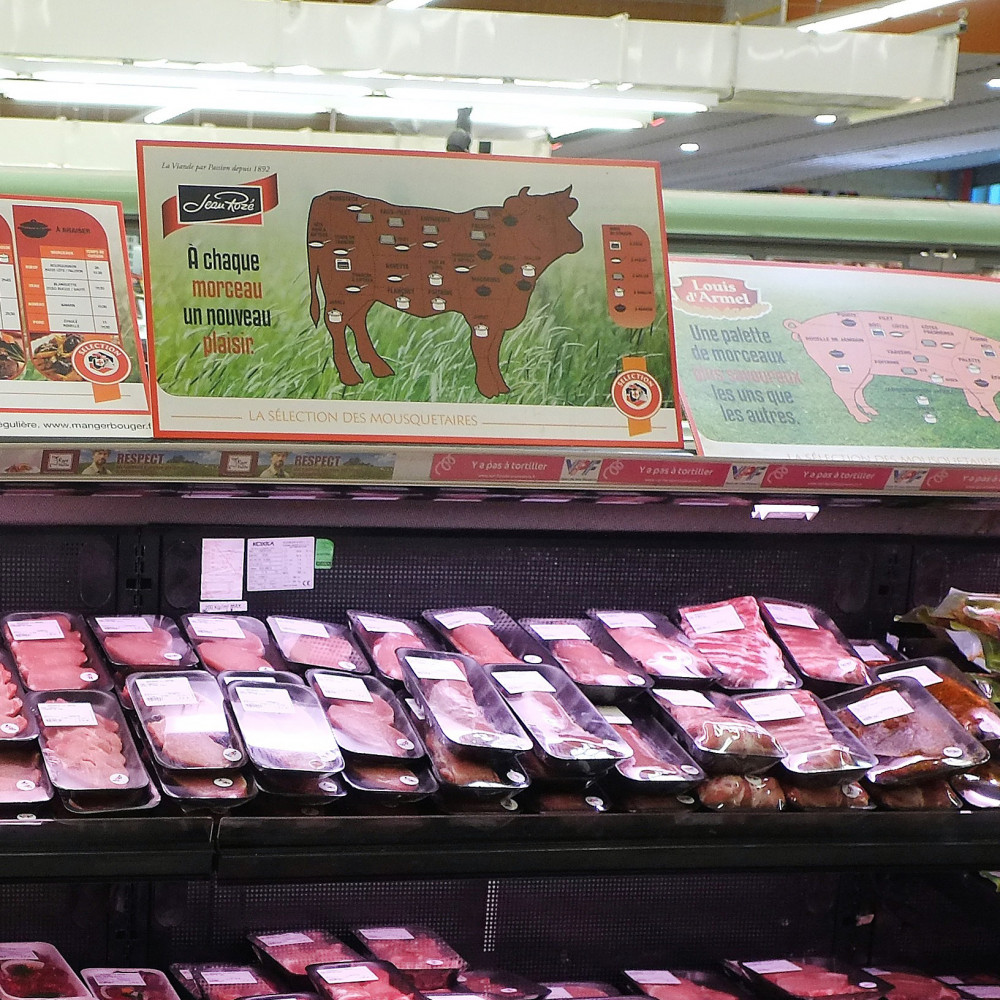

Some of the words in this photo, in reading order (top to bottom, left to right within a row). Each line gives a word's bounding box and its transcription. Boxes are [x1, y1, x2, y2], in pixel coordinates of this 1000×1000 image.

[172, 162, 194, 170] Viande
[208, 163, 230, 171] Passion
[231, 164, 251, 173] depuis
[254, 165, 270, 173] 1892
[183, 194, 225, 213] Jean
[188, 243, 198, 270] À
[203, 247, 260, 275] chaque
[192, 279, 262, 299] morceau
[692, 279, 736, 293] Louis
[686, 292, 751, 305] d'Armel
[184, 307, 202, 325] un
[207, 308, 271, 327] nouveau
[689, 324, 718, 342] Une
[721, 326, 772, 345] palette
[203, 331, 254, 357] plaisir.
[691, 345, 709, 361] de
[712, 349, 786, 364] morceaux
[711, 384, 734, 402] les
[738, 387, 761, 403] uns
[767, 390, 794, 406] que
[249, 410, 265, 421] LA
[268, 408, 338, 423] SÉLECTION
[343, 412, 366, 424] DES
[370, 412, 478, 426] MOUSQUETAIRES
[719, 404, 744, 422] les
[746, 409, 800, 425] autres.
[116, 453, 164, 465] RESPECT
[295, 454, 341, 467] RESPECT
[471, 461, 478, 470] Y
[486, 462, 502, 471] pas
[504, 460, 510, 470] à
[512, 462, 548, 471] tortiller
[678, 467, 714, 475] tortiller
[840, 471, 876, 479] tortiller
